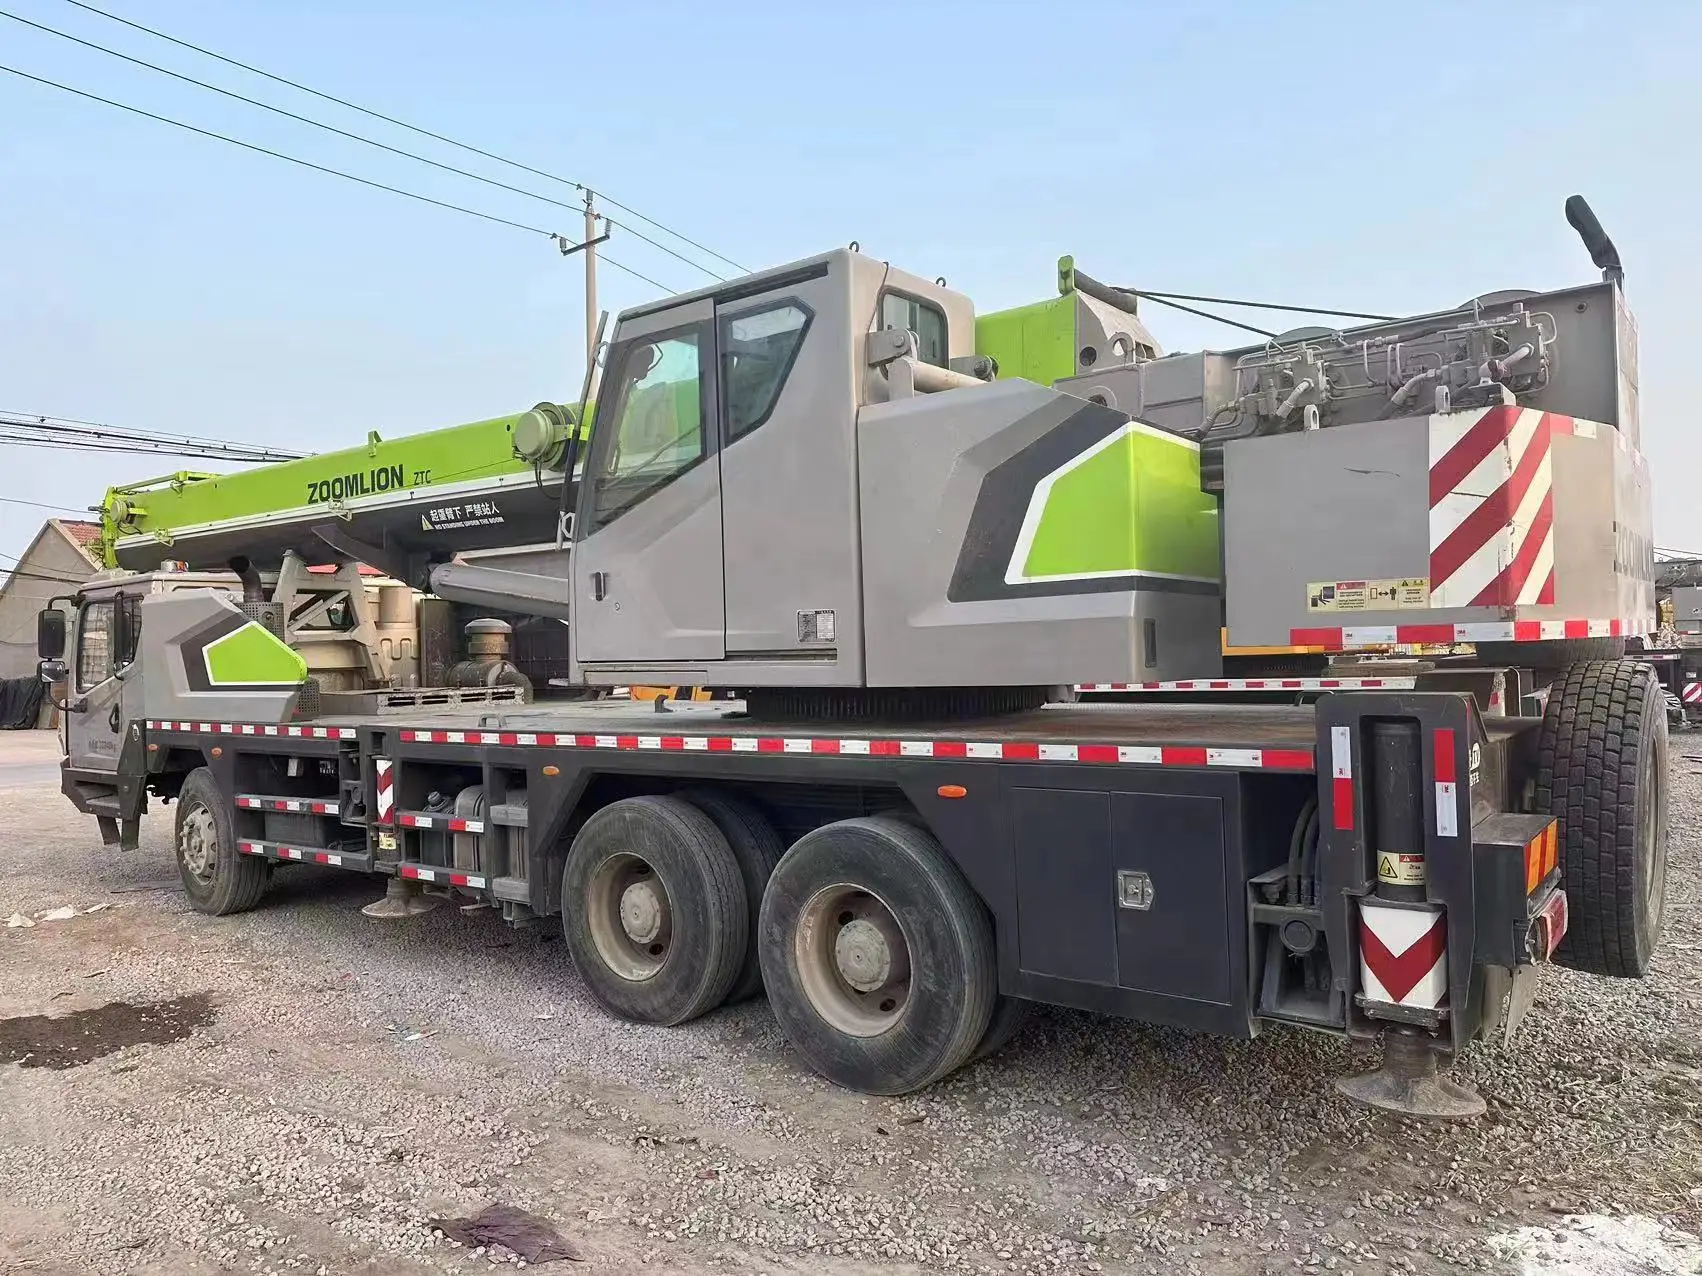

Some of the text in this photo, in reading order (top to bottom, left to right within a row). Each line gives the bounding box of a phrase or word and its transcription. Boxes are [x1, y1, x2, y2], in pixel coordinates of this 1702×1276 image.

[307, 464, 432, 505] ZOOMLION ZTC
[429, 500, 500, 522] 起重臂下 严禁站人
